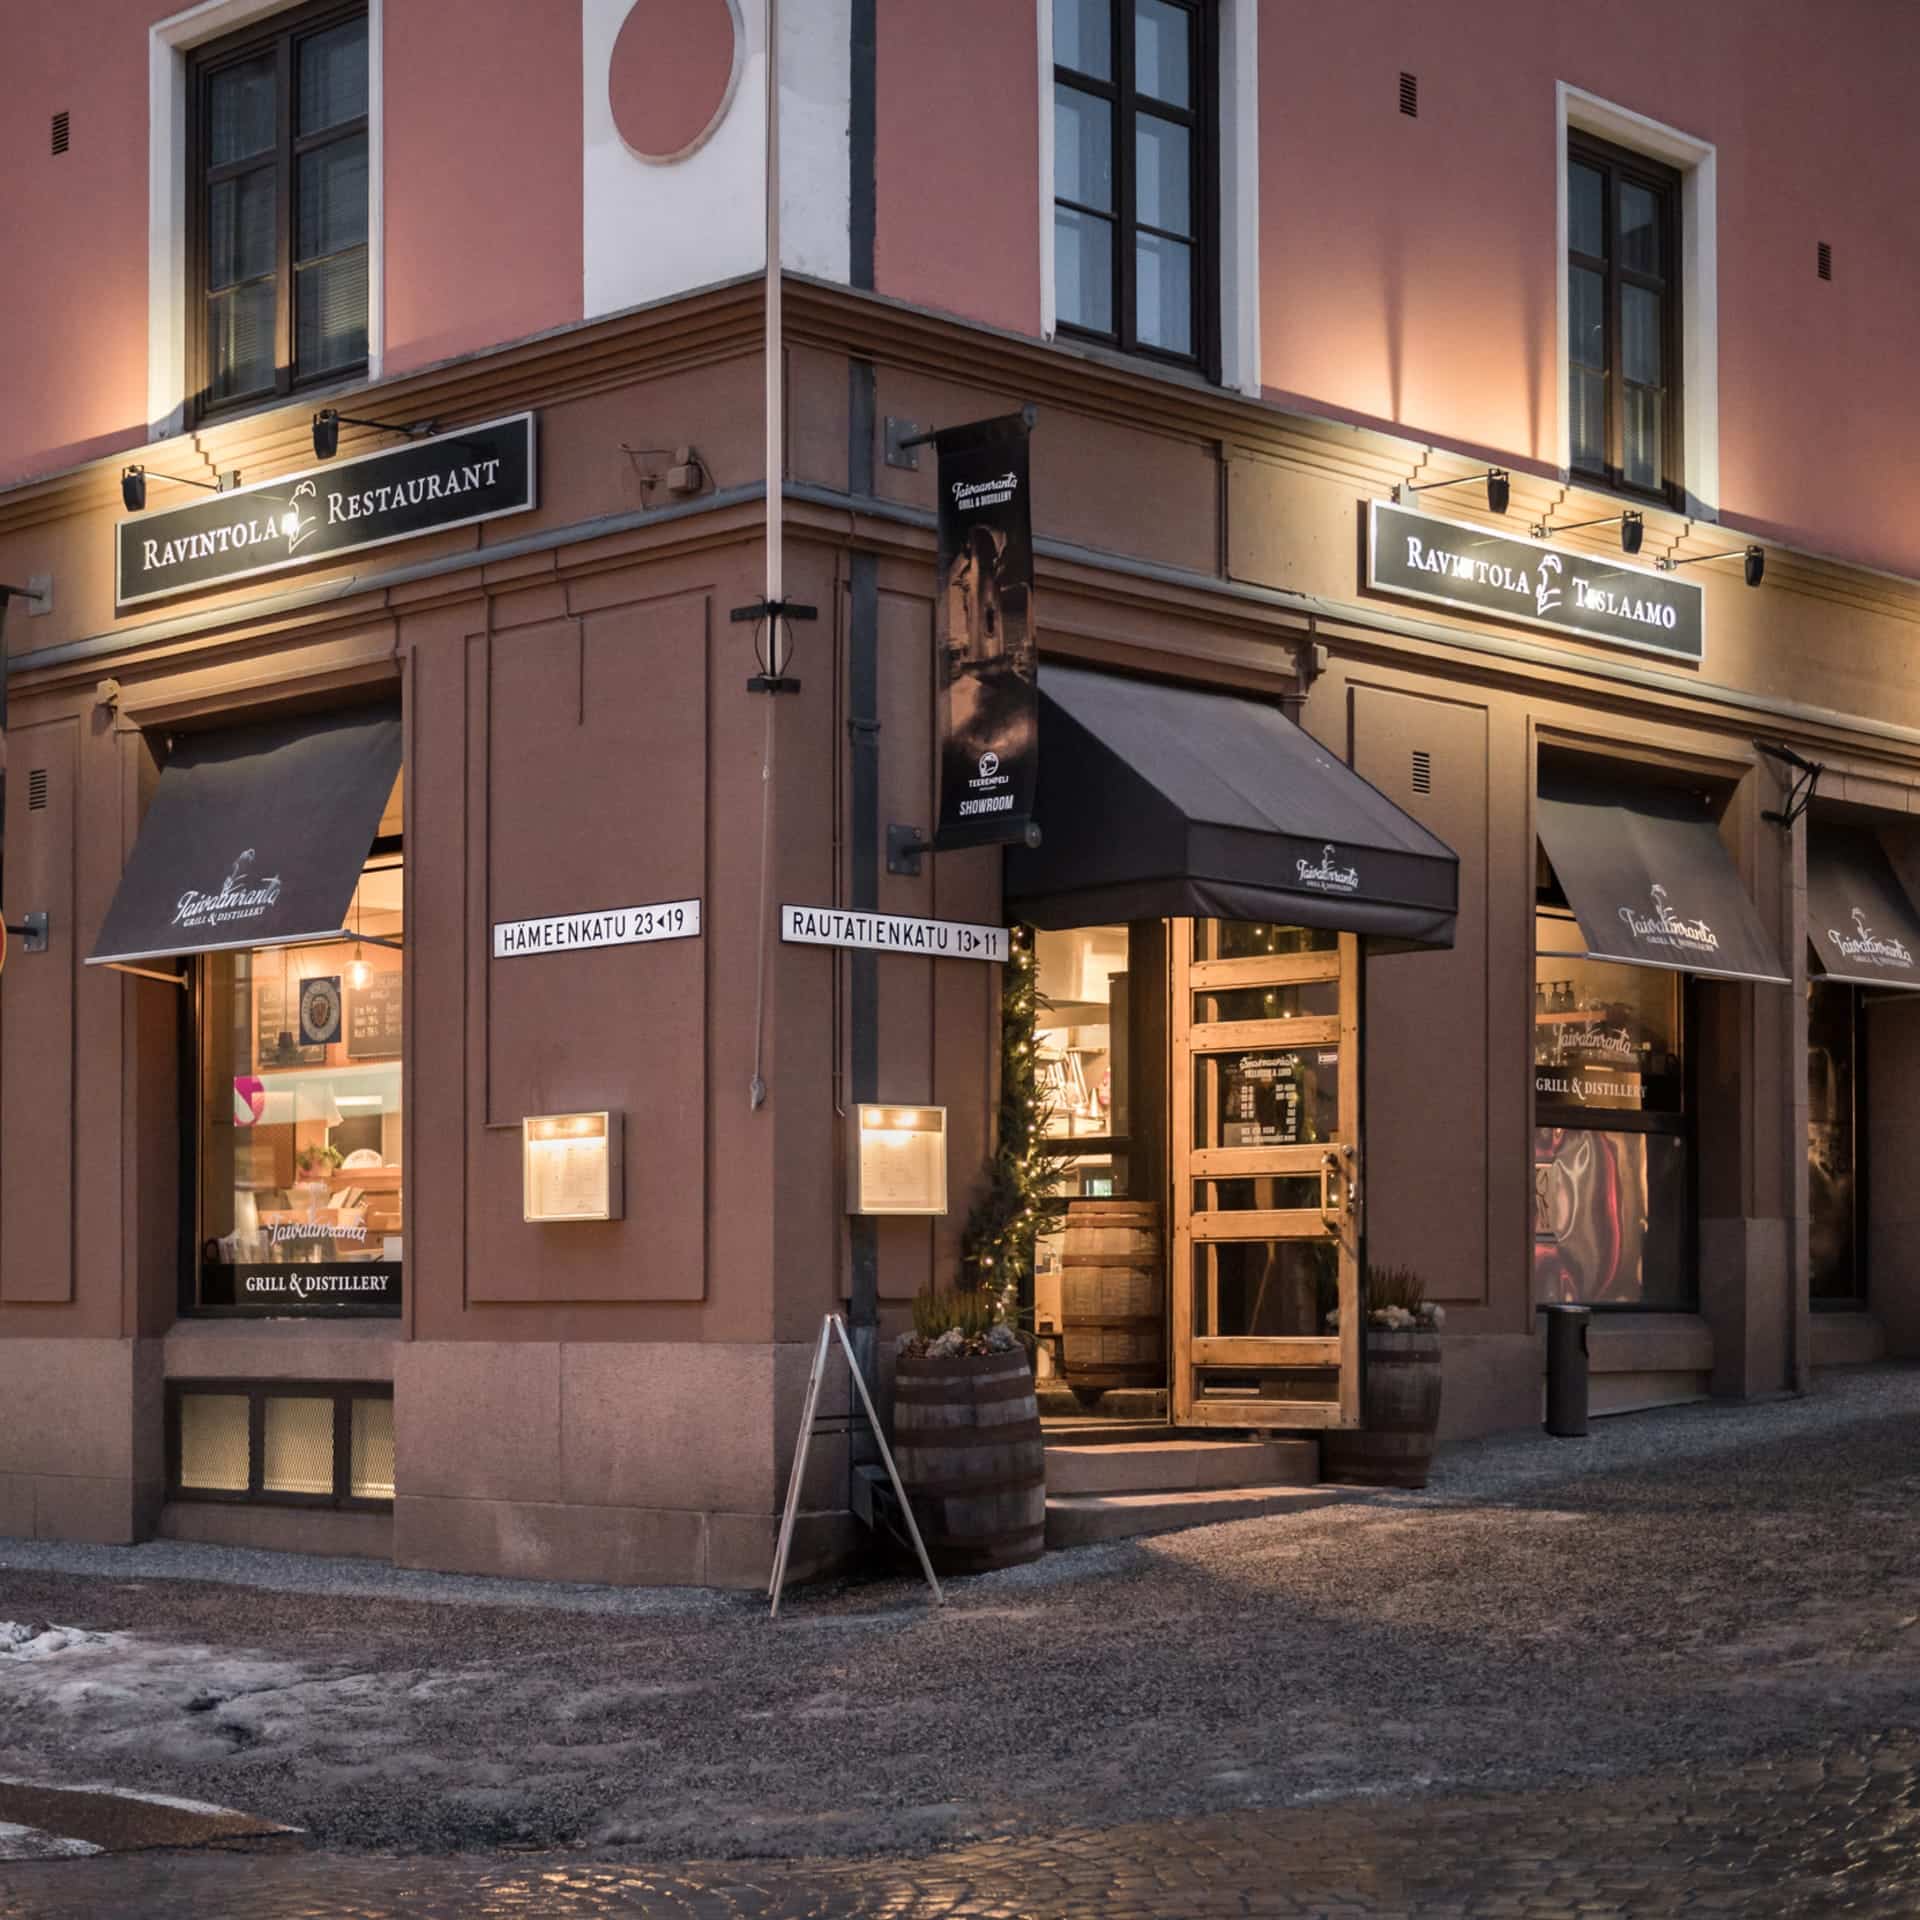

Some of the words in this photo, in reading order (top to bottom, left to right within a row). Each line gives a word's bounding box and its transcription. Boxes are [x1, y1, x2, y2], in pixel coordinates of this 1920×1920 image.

[143, 522, 279, 570] RAVINTOLA
[327, 459, 500, 525] RESTAURANT
[960, 794, 1014, 816] SHOWROOM
[504, 915, 626, 951] HÄMEENKATU
[793, 912, 948, 949] RAUTATIENKATU
[1536, 1078, 1569, 1093] GRILL
[1571, 1077, 1587, 1101] &
[1584, 1081, 1647, 1098] DISTILLERY
[246, 1276, 286, 1291] GRILL
[289, 1272, 308, 1298] &
[306, 1276, 389, 1291] DISTILLERY
